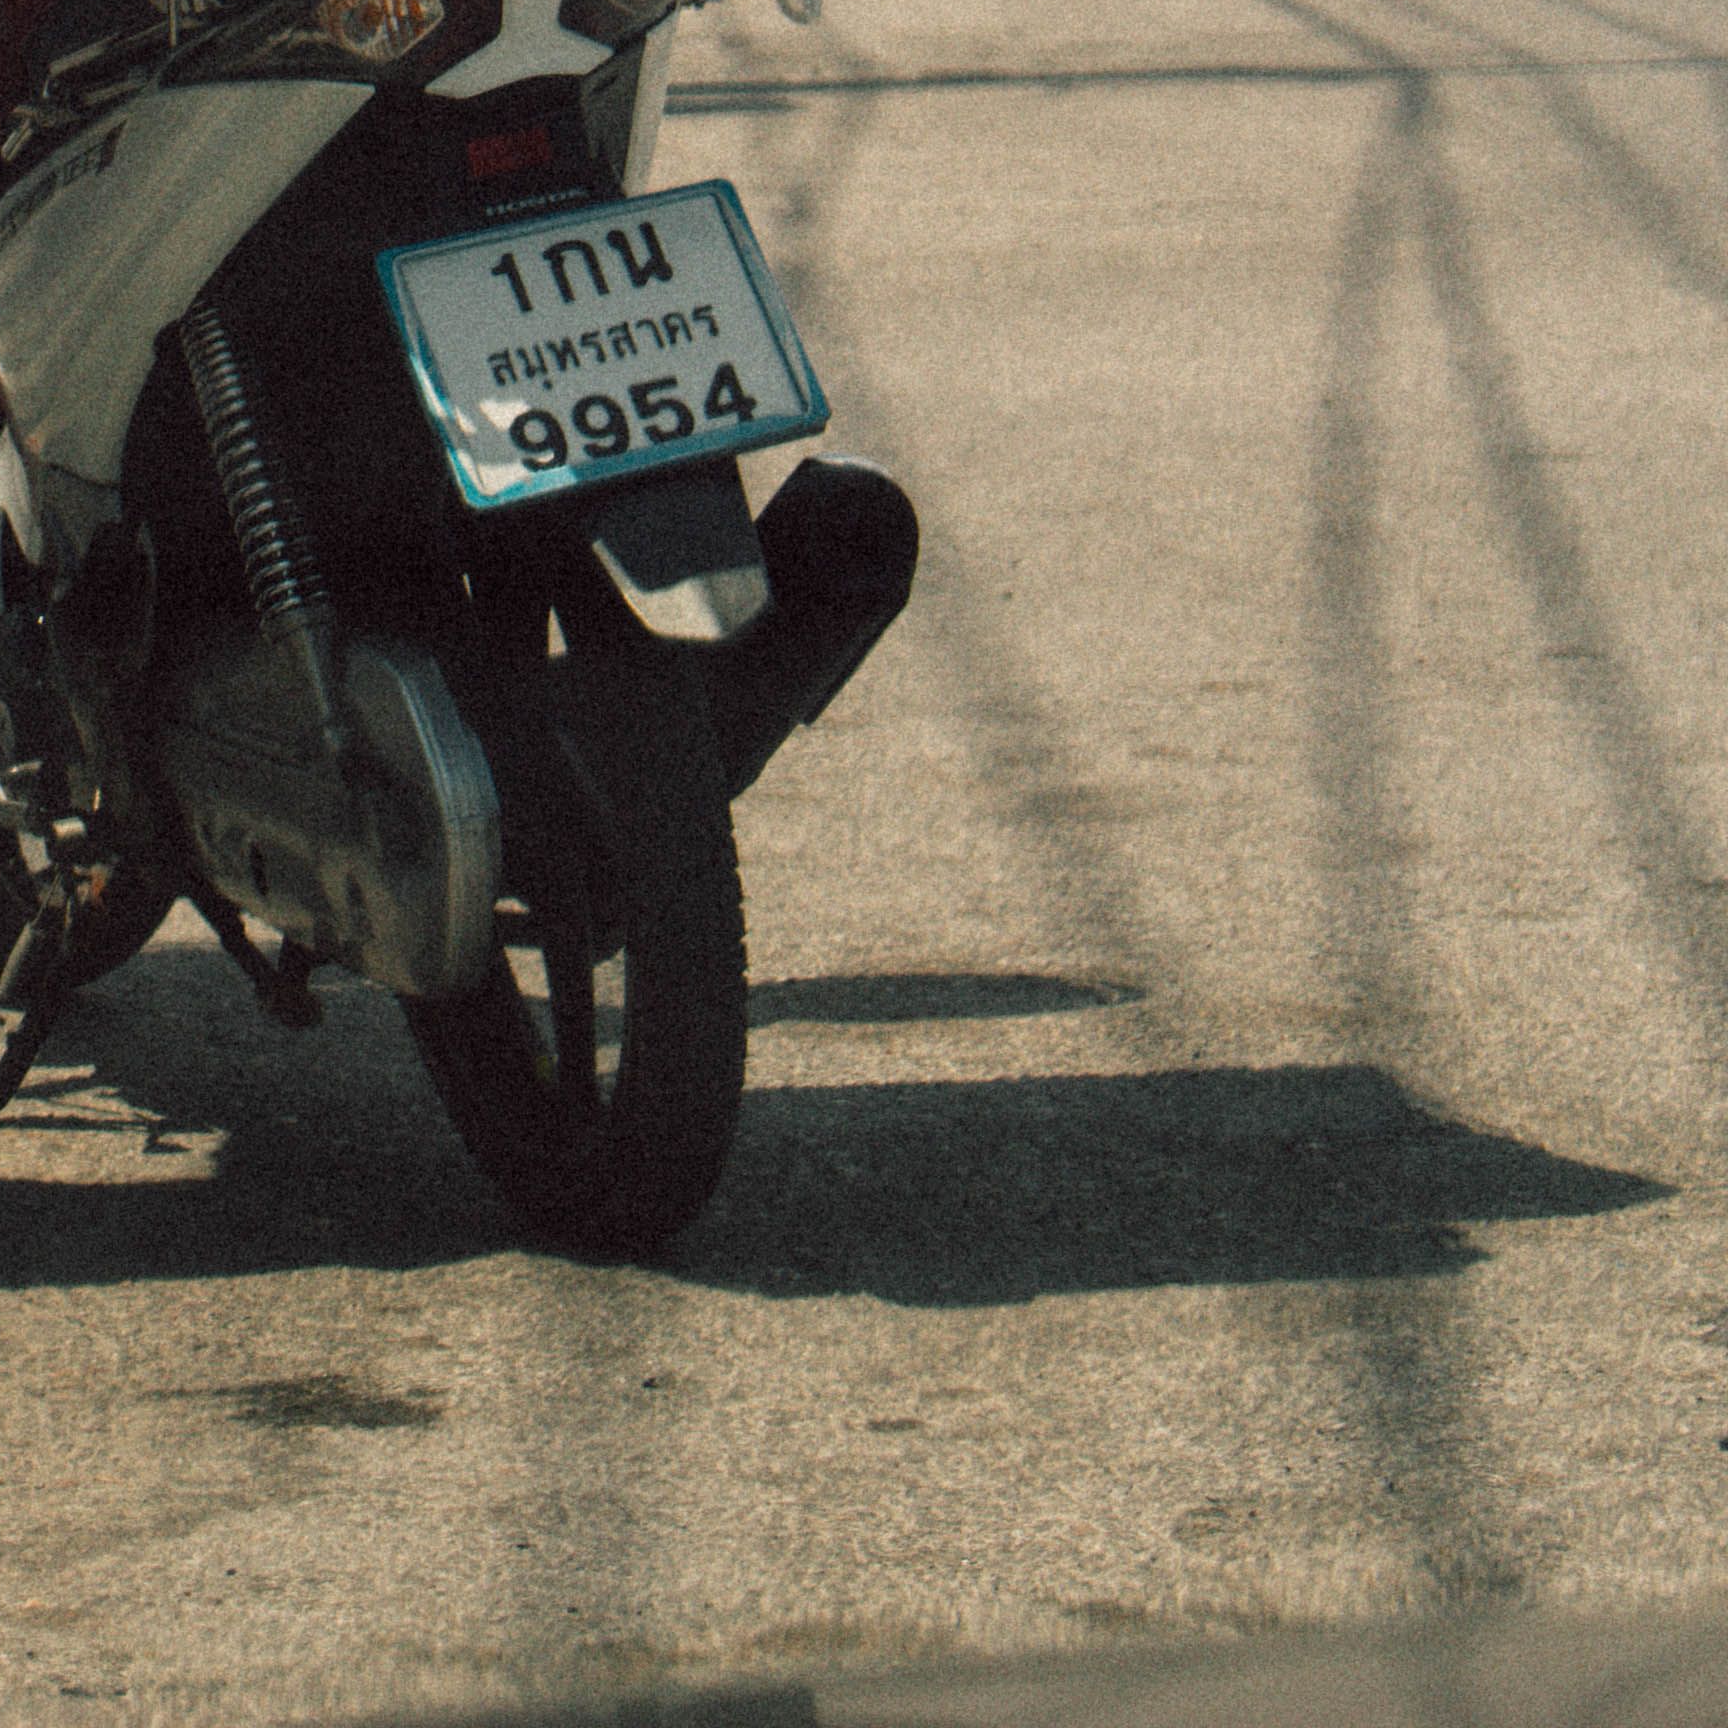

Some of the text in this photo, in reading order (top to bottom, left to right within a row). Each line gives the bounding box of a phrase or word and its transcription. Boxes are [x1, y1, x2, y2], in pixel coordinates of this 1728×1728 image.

[490, 221, 674, 314] 1กน
[486, 303, 720, 391] สมุทรสาคร
[508, 361, 758, 474] 9954
